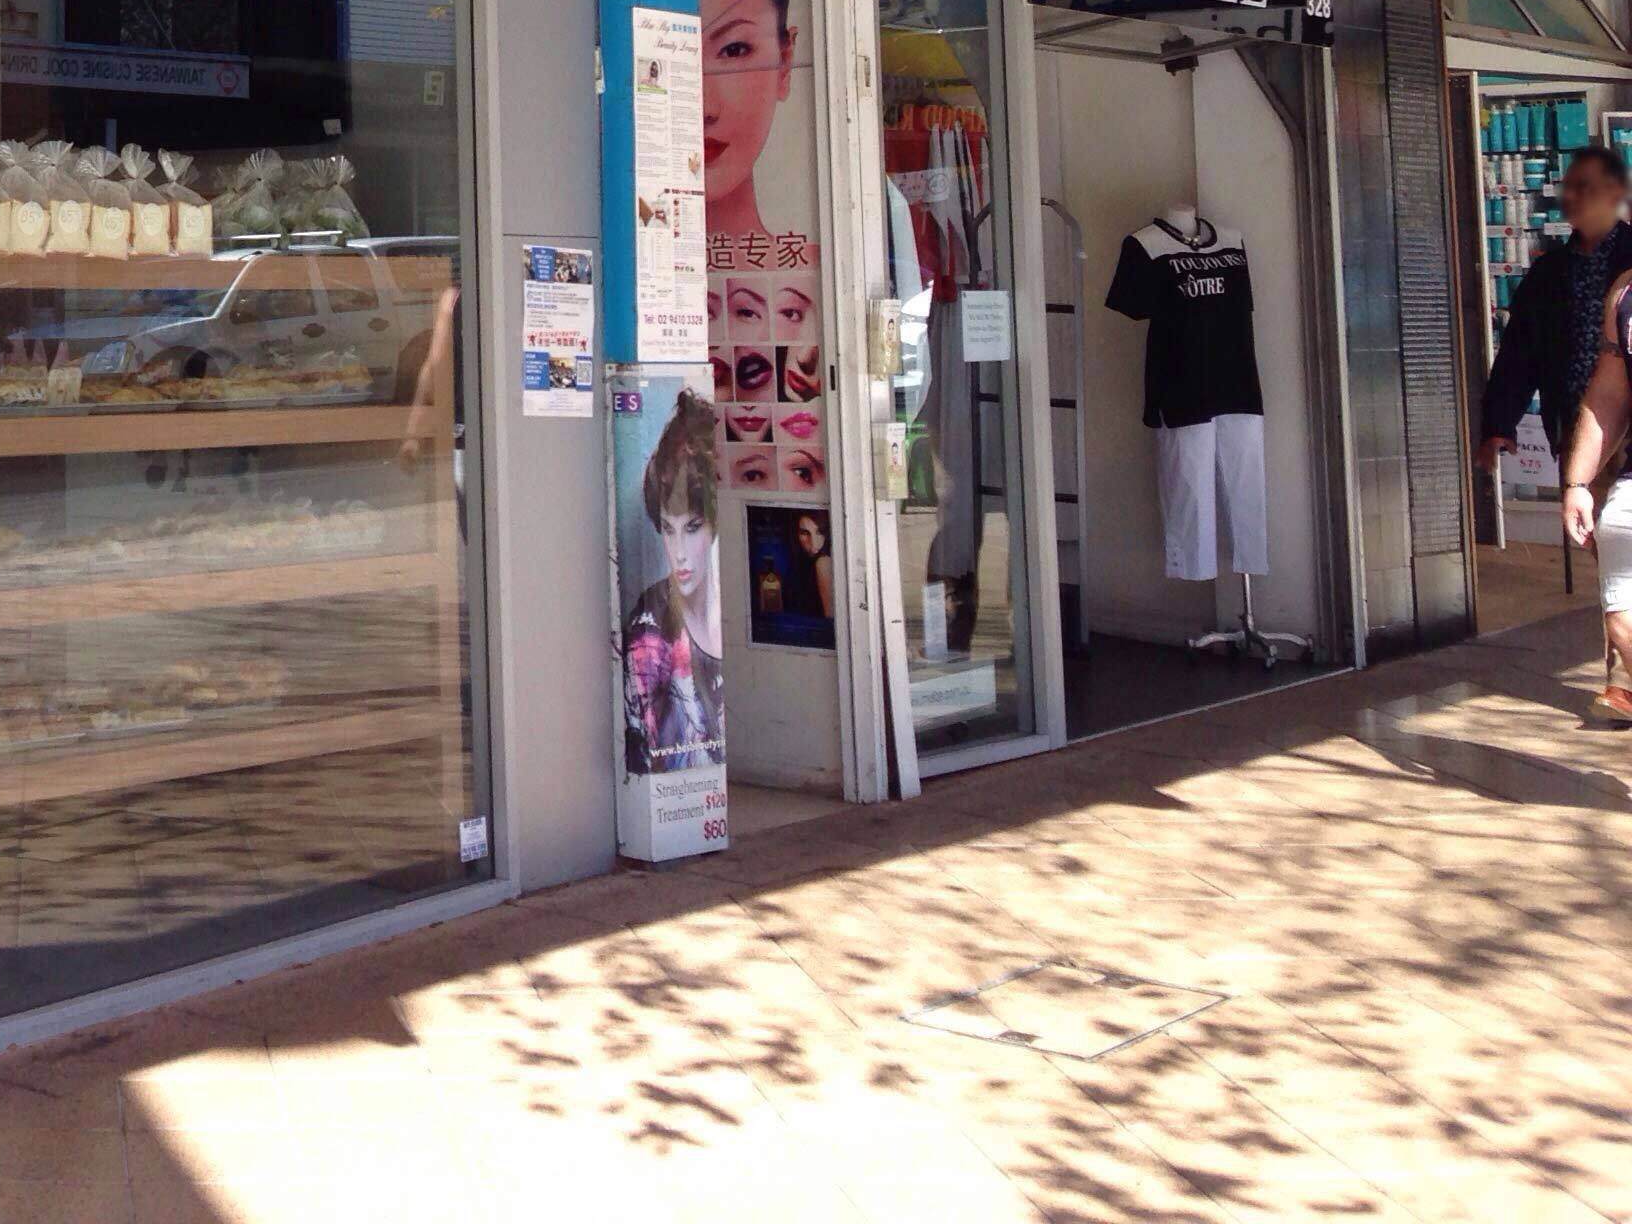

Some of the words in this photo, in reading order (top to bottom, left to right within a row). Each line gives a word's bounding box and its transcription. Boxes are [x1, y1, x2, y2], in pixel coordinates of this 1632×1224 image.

[706, 231, 809, 270] 造专家
[703, 819, 727, 841] $60
